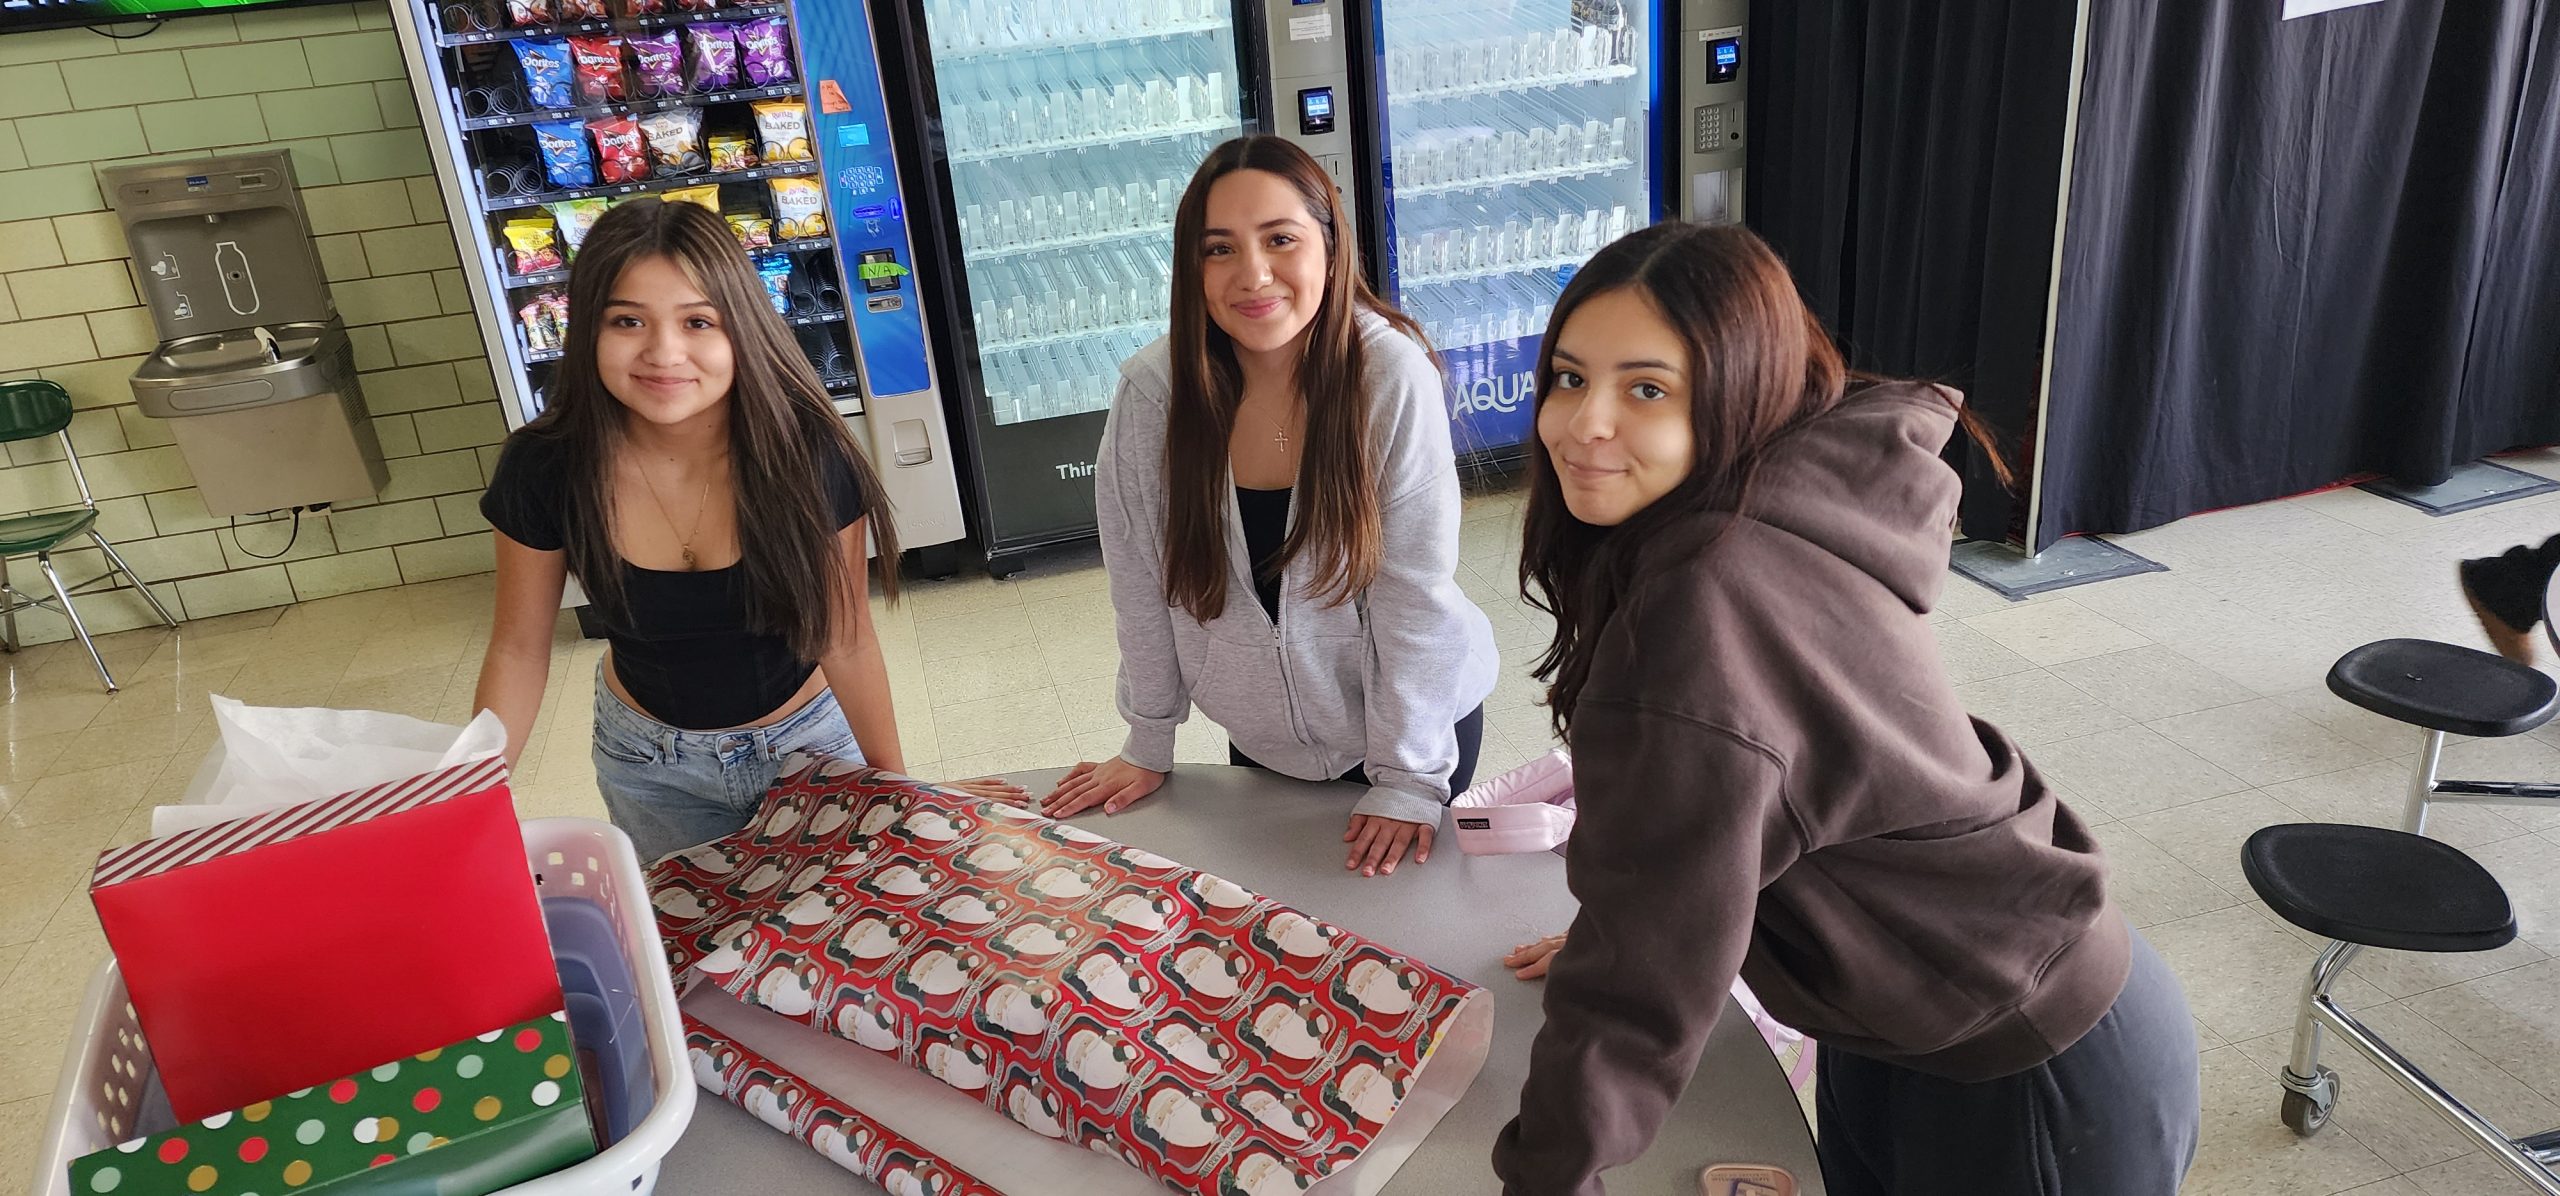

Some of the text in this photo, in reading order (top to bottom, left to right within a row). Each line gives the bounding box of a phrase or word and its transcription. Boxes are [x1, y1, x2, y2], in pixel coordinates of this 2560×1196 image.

[522, 57, 560, 68] Doritos
[638, 52, 672, 64] Doritos
[765, 121, 801, 130] BAKED
[648, 127, 683, 141] BAKED
[540, 139, 577, 149] Doritos
[781, 196, 818, 205] BAKED
[868, 265, 892, 278] N/A
[1452, 371, 1536, 420] AQUA
